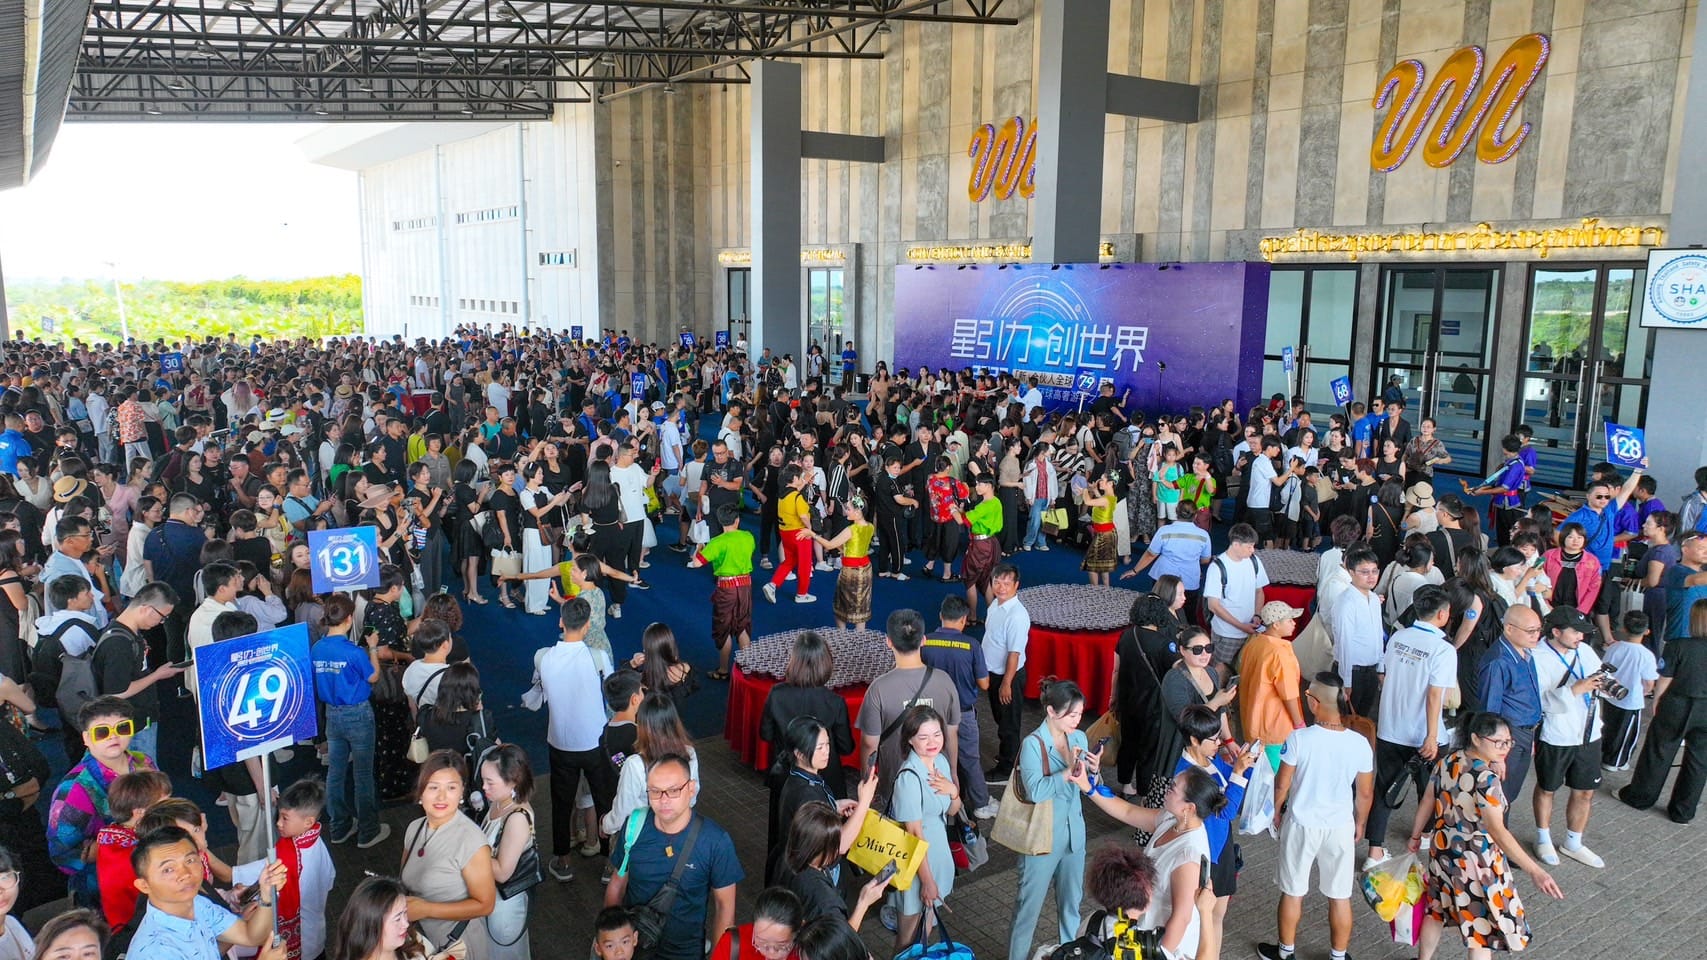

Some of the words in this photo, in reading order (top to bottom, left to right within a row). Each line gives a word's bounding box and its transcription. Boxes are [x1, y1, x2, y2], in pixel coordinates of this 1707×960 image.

[1669, 284, 1706, 294] SHA
[164, 358, 178, 369] 30
[632, 380, 644, 395] 127
[1079, 374, 1096, 389] 79
[1337, 384, 1349, 399] 68
[1610, 435, 1642, 459] 128
[318, 544, 367, 578] 131
[228, 666, 289, 729] 49
